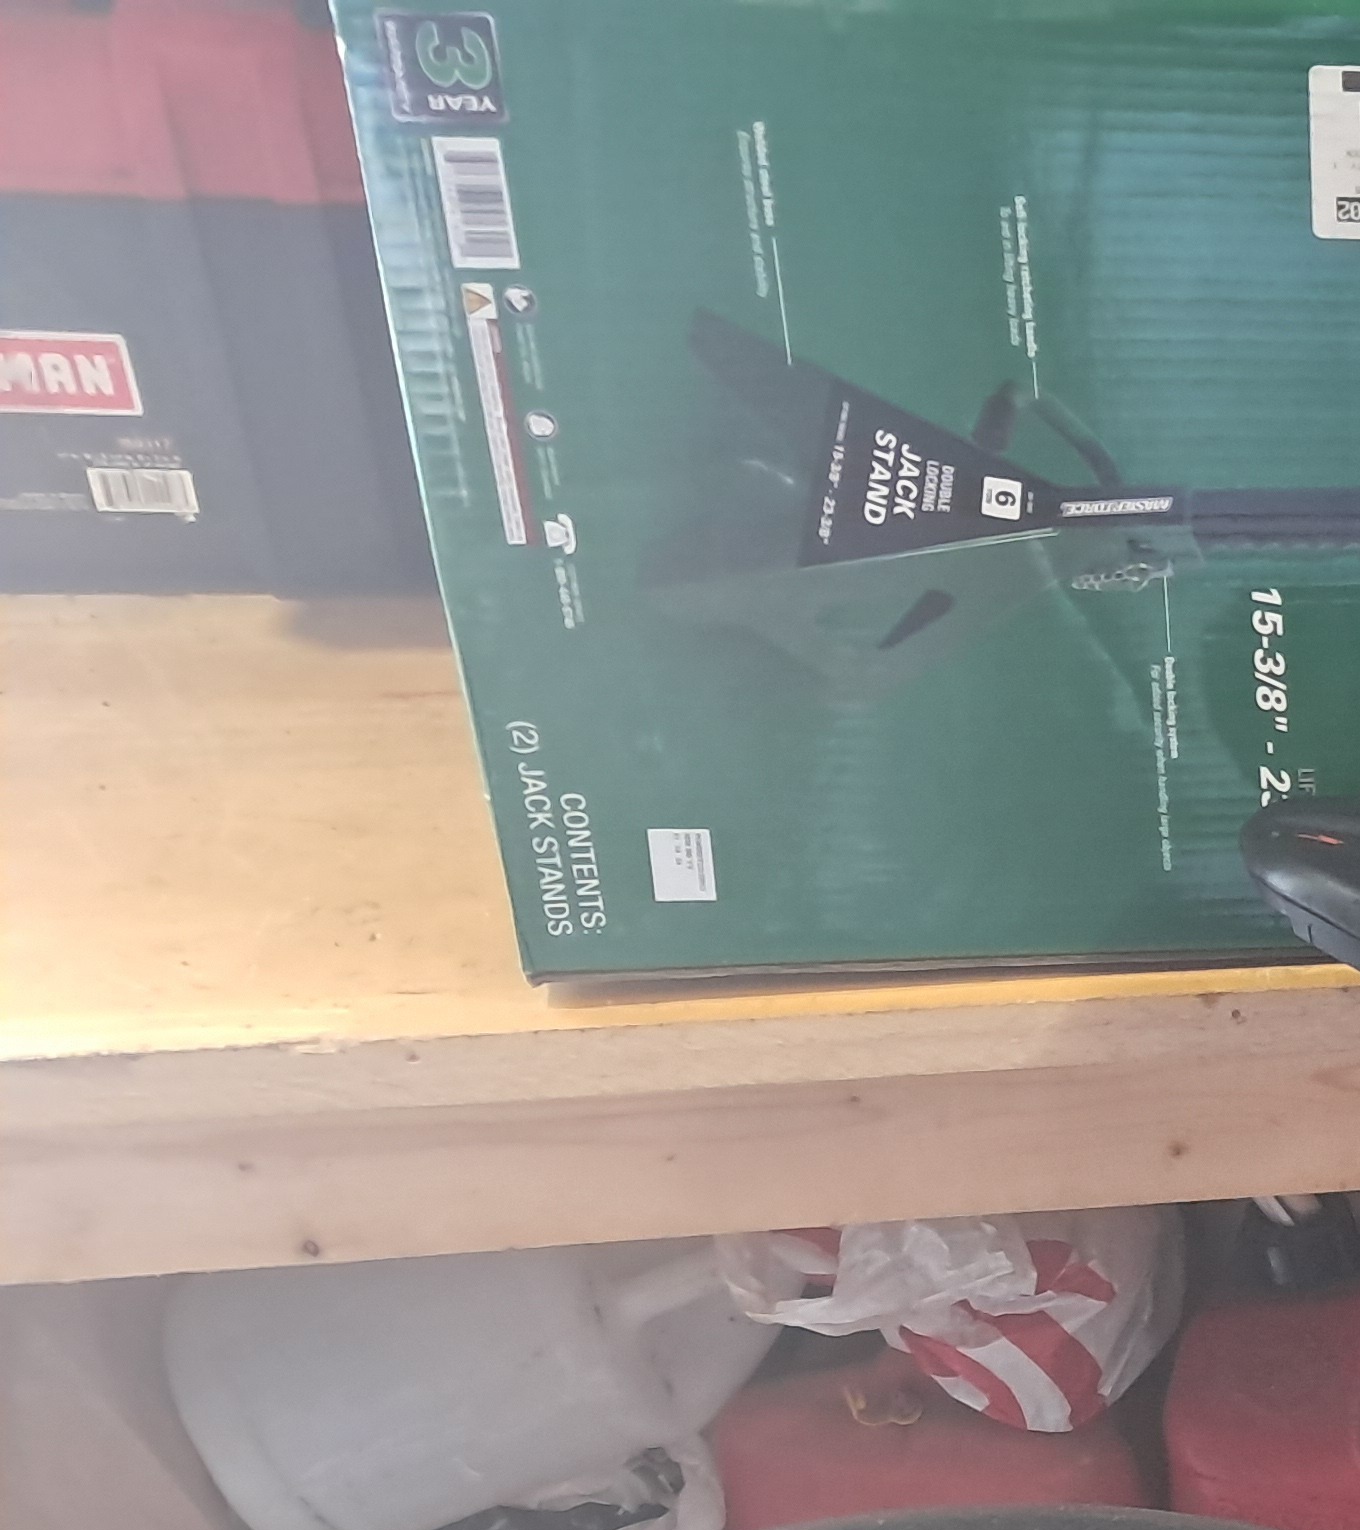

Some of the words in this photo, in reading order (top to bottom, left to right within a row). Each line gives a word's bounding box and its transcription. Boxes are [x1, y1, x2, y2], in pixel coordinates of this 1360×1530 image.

[415, 20, 492, 91] 3
[427, 93, 497, 113] YEAR
[0, 352, 115, 397] MAN
[863, 429, 897, 526] STAND
[893, 443, 922, 520] JACK
[921, 460, 940, 513] LOCKING
[937, 465, 955, 513] DOUBLE
[995, 490, 1016, 507] 6
[1251, 588, 1288, 733] 15-3/8"
[506, 720, 540, 755] (2)
[518, 762, 556, 840] JACK
[1297, 768, 1317, 796] LIF
[530, 843, 575, 937] STANDS
[560, 792, 607, 935] CONTENTS:
